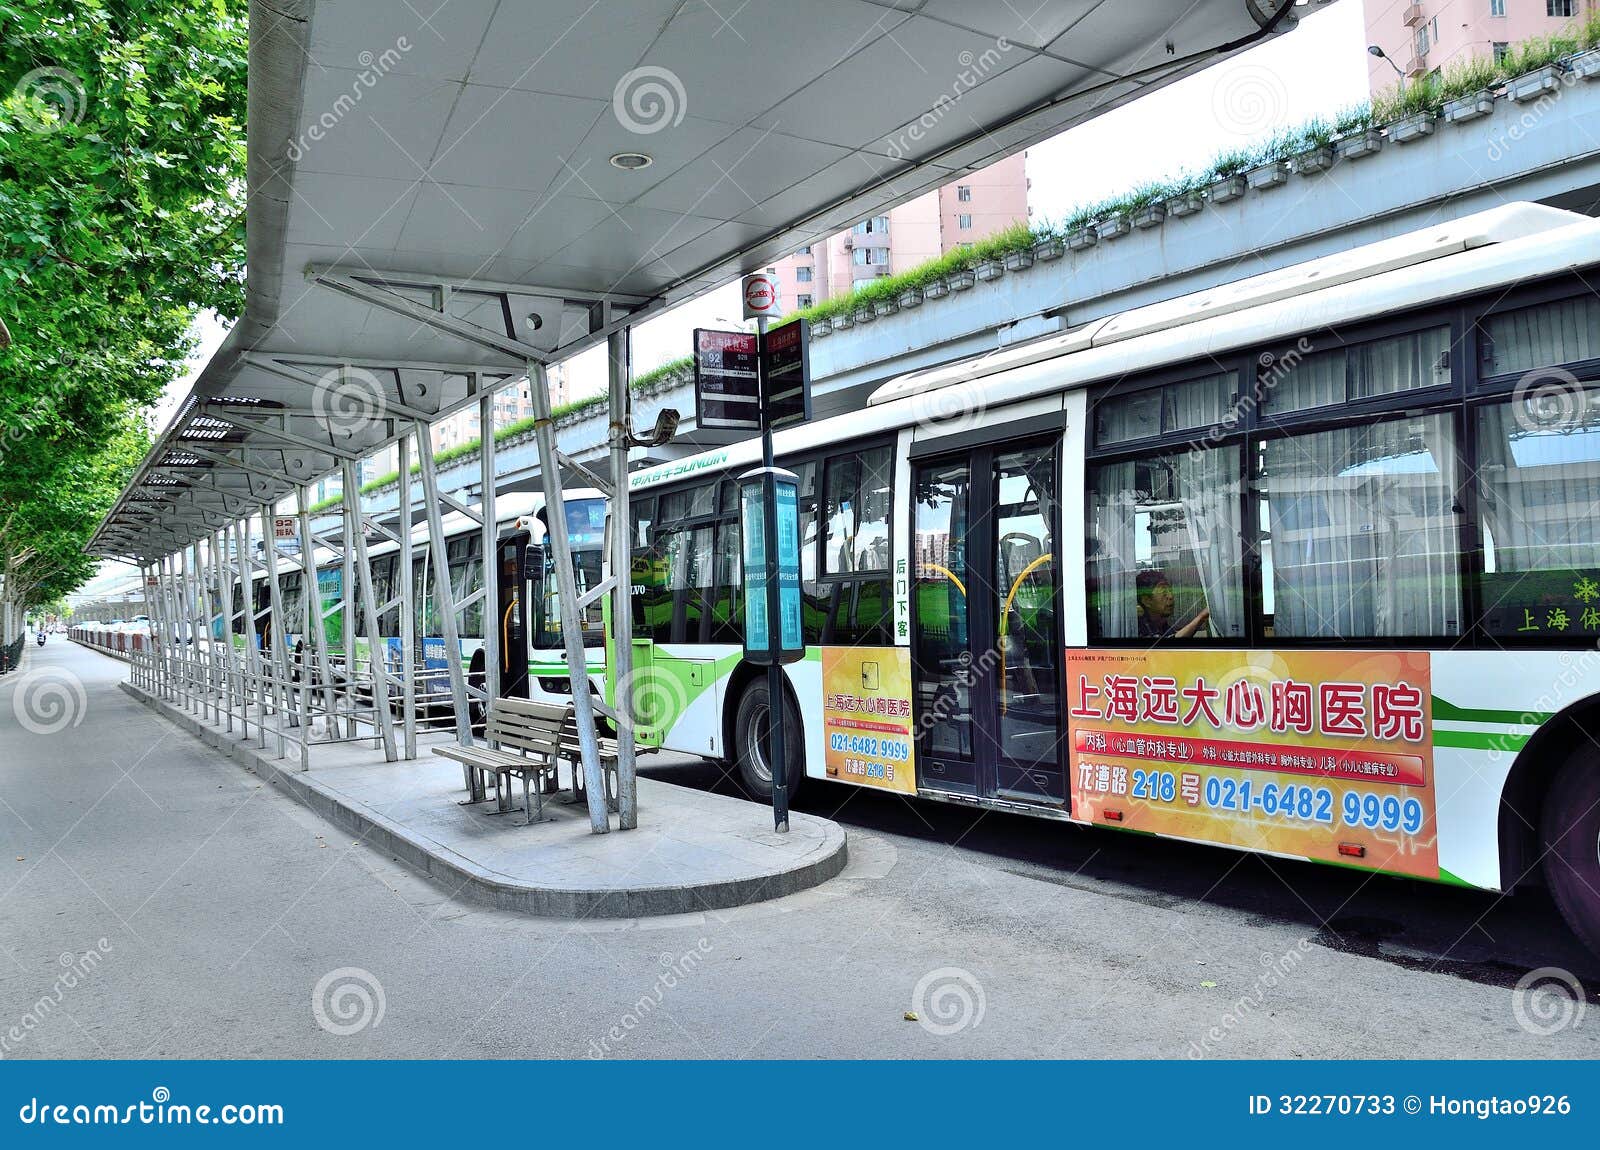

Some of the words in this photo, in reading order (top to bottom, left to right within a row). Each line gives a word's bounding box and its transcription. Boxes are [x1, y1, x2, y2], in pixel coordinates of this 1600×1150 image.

[708, 353, 720, 363] 92
[275, 519, 293, 527] 92
[275, 529, 294, 537] 排队
[895, 558, 908, 637] 后门下客
[825, 692, 910, 718] 上海远大心胸医院
[1070, 675, 1424, 743] 上海远大心胸医院
[831, 733, 878, 756] 021-6482
[881, 740, 909, 761] 9999
[867, 761, 885, 778] 218
[886, 764, 895, 781] 号
[1077, 762, 1128, 796] 龙漕路
[1132, 768, 1176, 802] 218
[1181, 773, 1201, 806] 号
[1205, 775, 1334, 824] 021-6482
[1342, 790, 1424, 835] 9999
